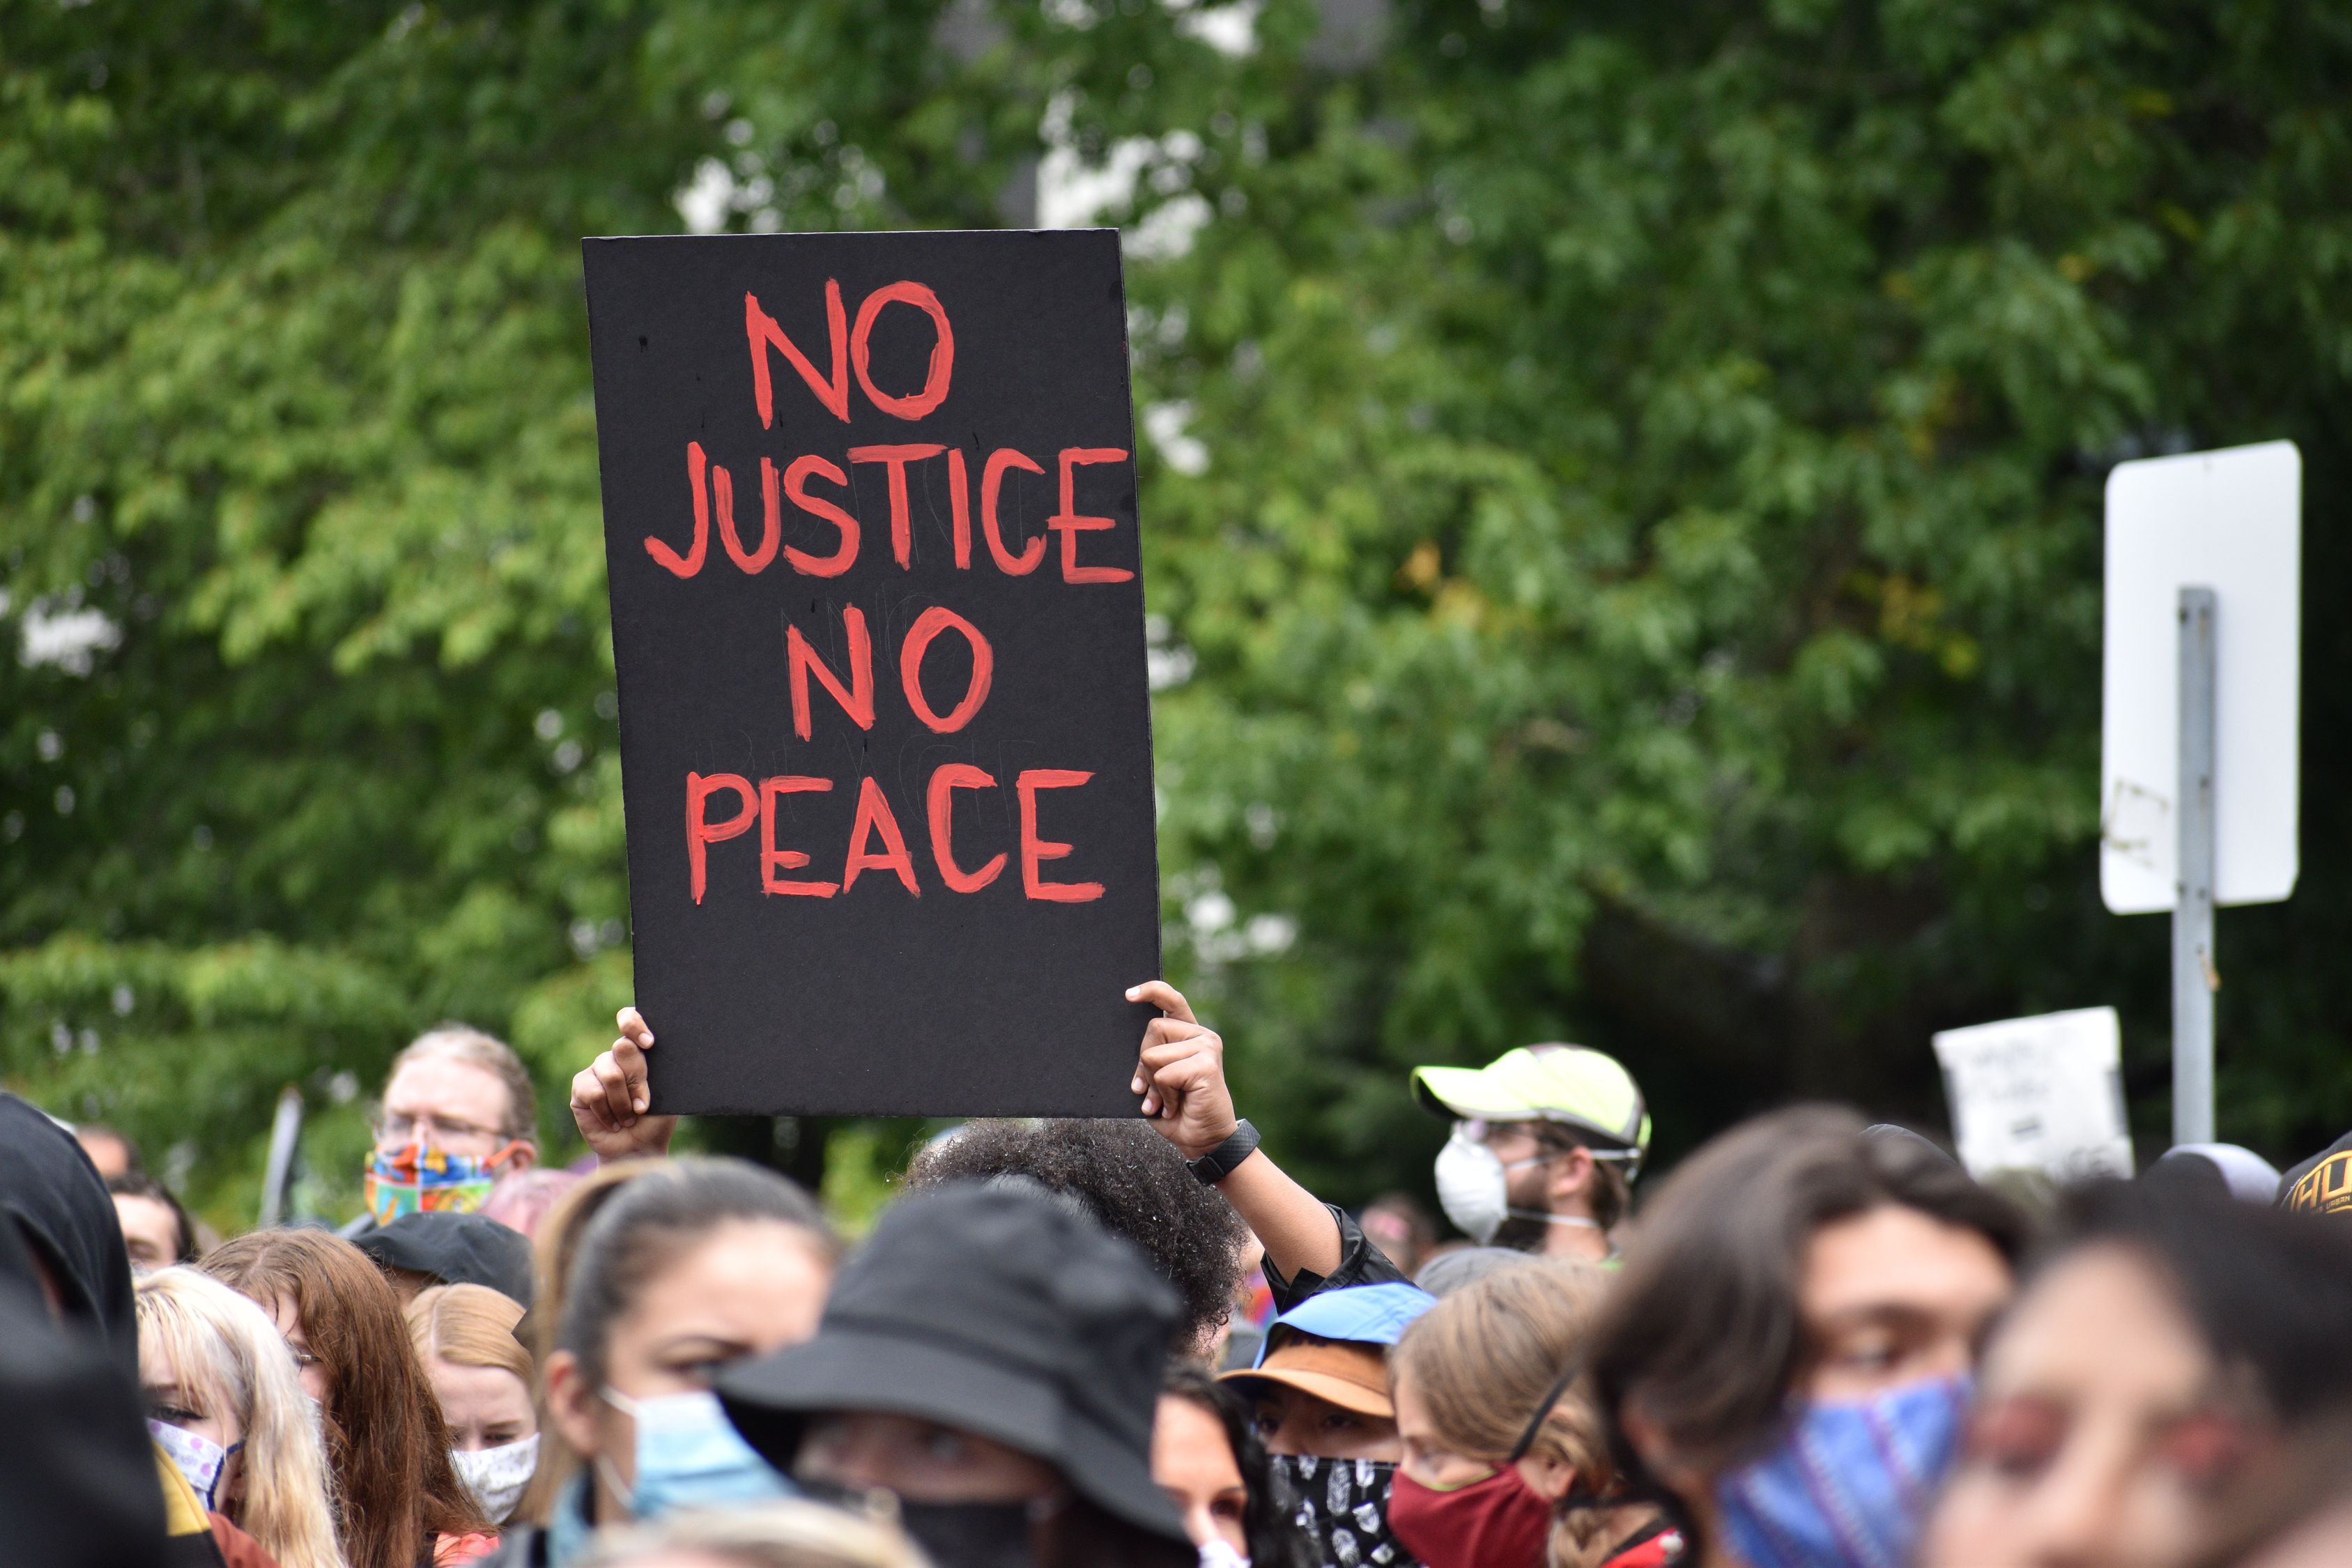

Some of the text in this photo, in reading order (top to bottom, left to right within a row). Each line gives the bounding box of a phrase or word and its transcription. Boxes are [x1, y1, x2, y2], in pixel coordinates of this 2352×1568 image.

[745, 278, 954, 429] NO
[644, 440, 1135, 584] JUSTICE
[786, 602, 993, 741] NO
[685, 762, 1105, 906] PEACE
